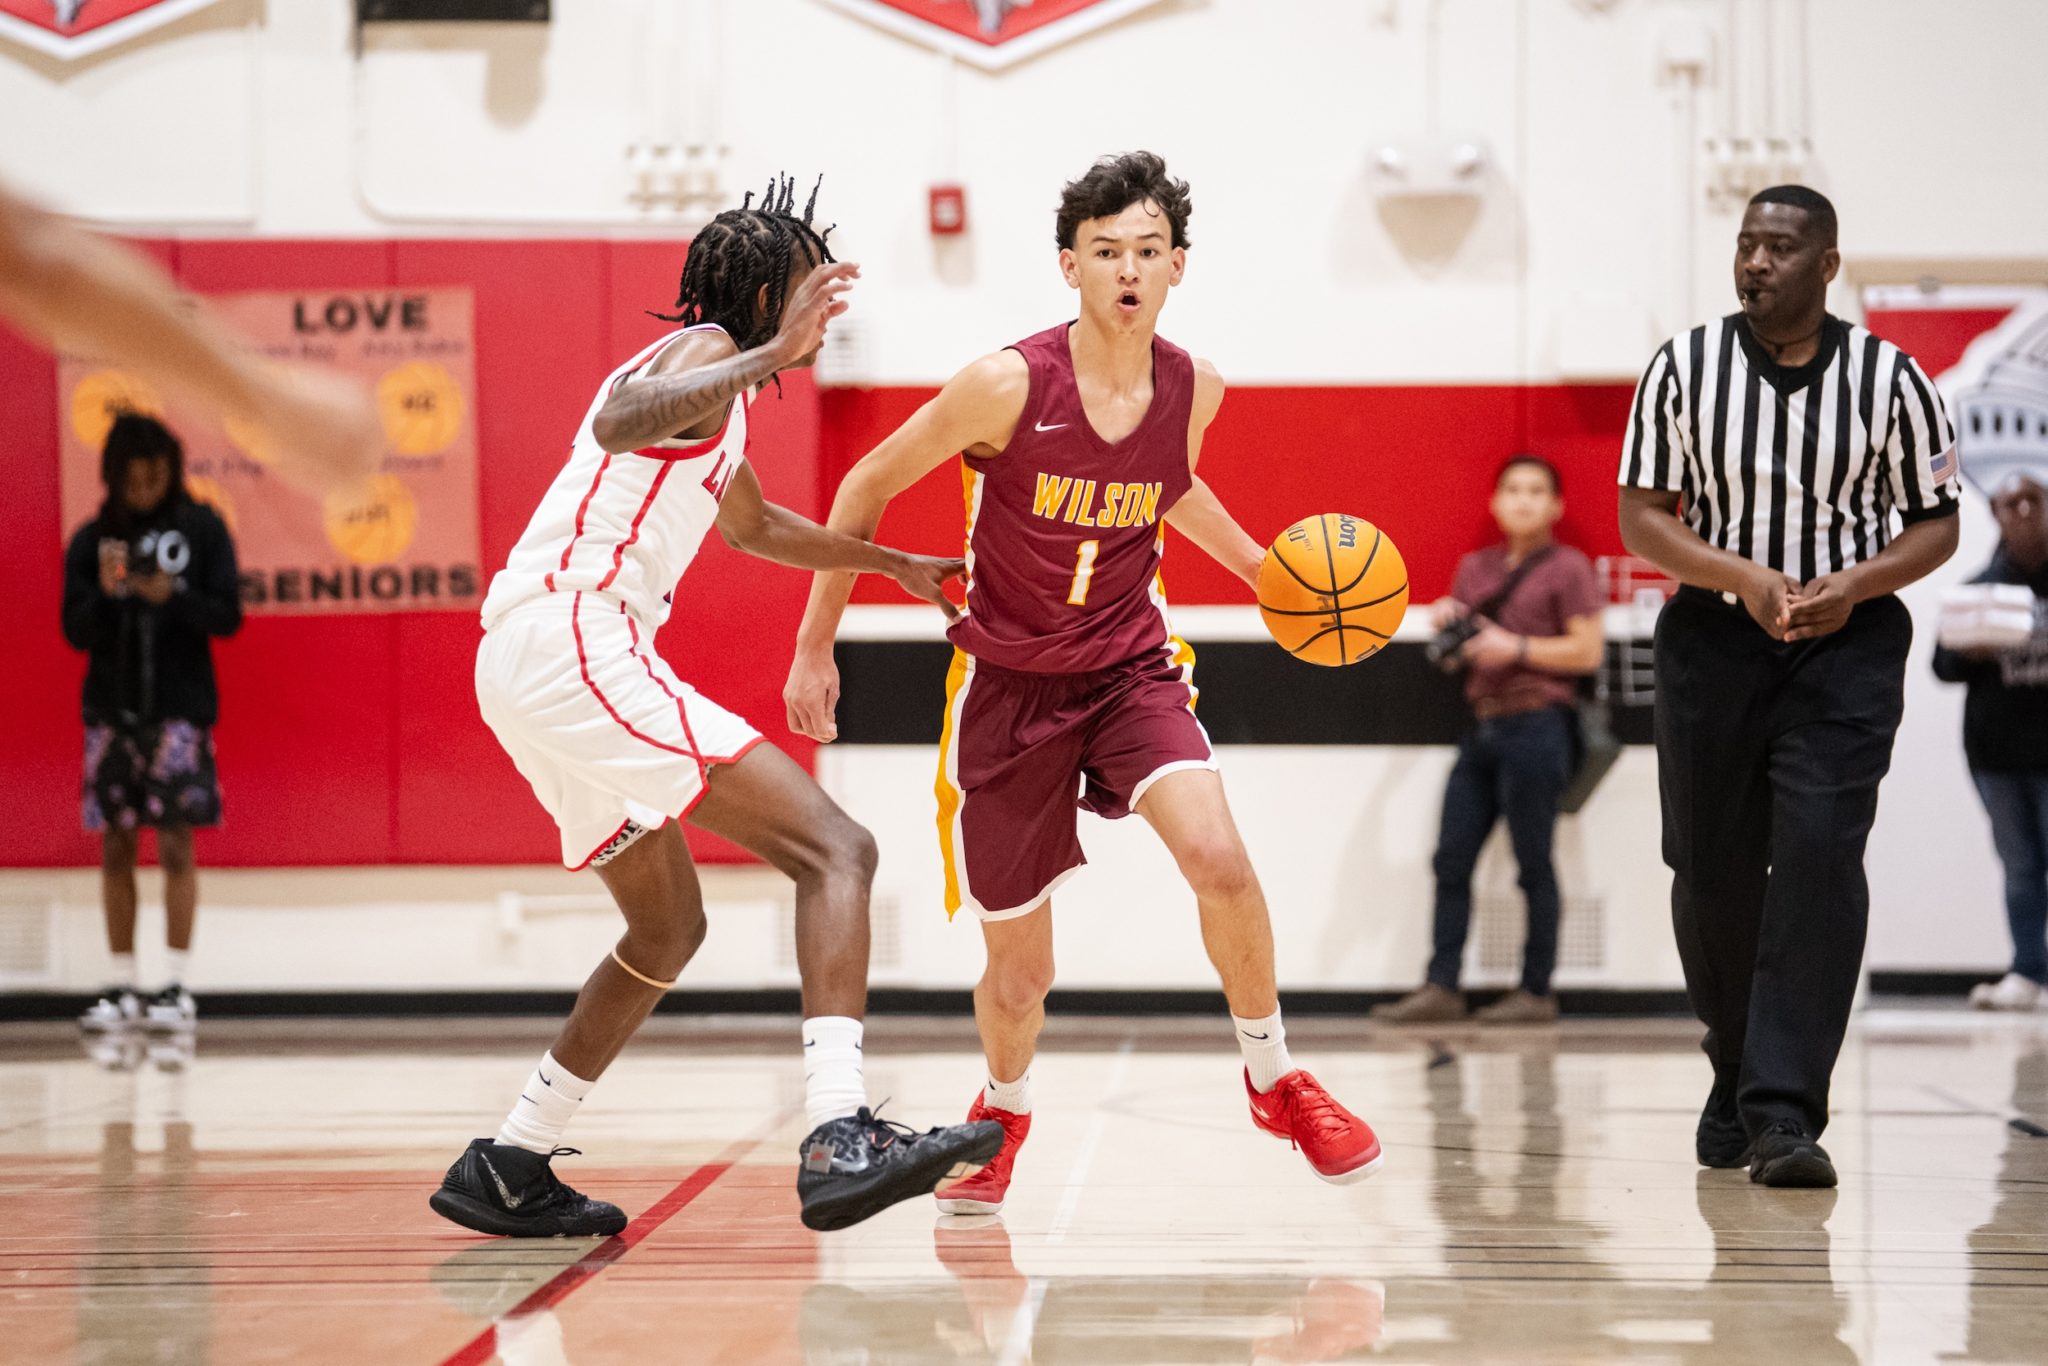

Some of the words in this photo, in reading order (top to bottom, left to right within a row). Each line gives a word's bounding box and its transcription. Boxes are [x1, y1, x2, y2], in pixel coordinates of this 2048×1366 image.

[294, 296, 426, 333] LOVE
[1032, 472, 1162, 527] WILSON
[239, 565, 476, 603] SENIORS
[1066, 539, 1099, 606] 1
